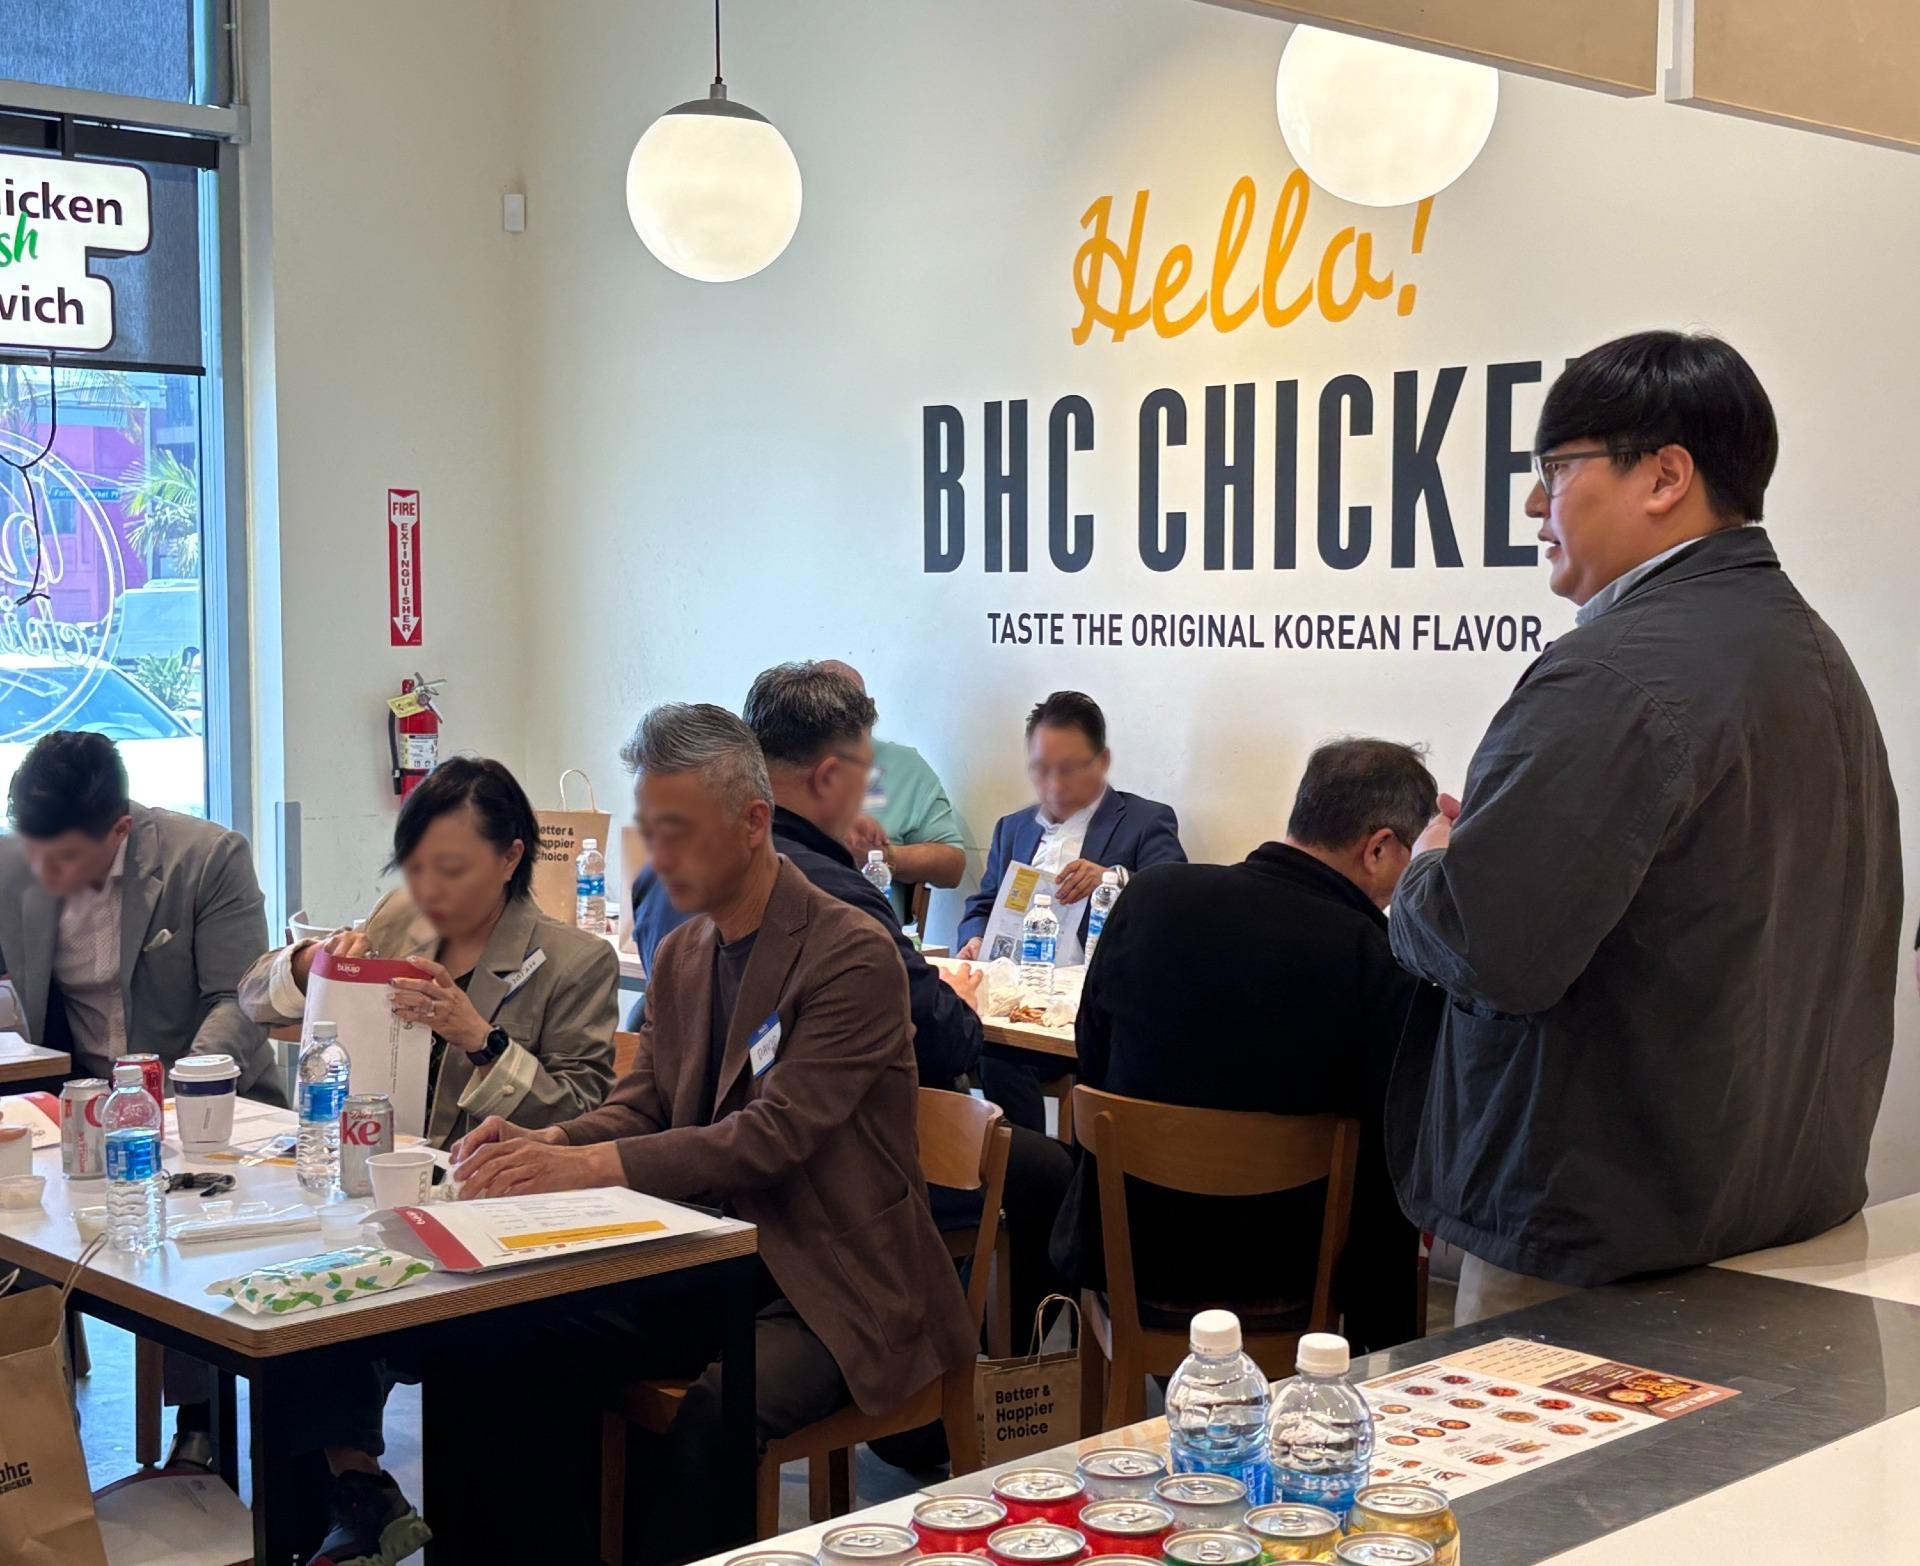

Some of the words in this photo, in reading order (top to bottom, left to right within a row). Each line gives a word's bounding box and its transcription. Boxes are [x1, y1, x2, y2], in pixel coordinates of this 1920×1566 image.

[0, 178, 122, 226] icken
[1071, 167, 1435, 346] Hello!
[923, 394, 1094, 573] BHC
[1138, 357, 1580, 572] CHICKE
[392, 501, 416, 517] FIRE
[400, 522, 412, 633] EXTINGUISHER
[987, 612, 1064, 645] TASTE
[1072, 613, 1123, 646] THE
[1131, 613, 1265, 648] ORIGINAL
[1274, 614, 1400, 650] KOREAN
[1413, 614, 1542, 652] FLAVOR
[538, 825, 566, 836] etter
[540, 838, 575, 849] appier
[995, 1387, 1040, 1405] Better
[1042, 1384, 1051, 1397] &
[996, 1402, 1054, 1422] Happier
[996, 1422, 1049, 1441] Choice
